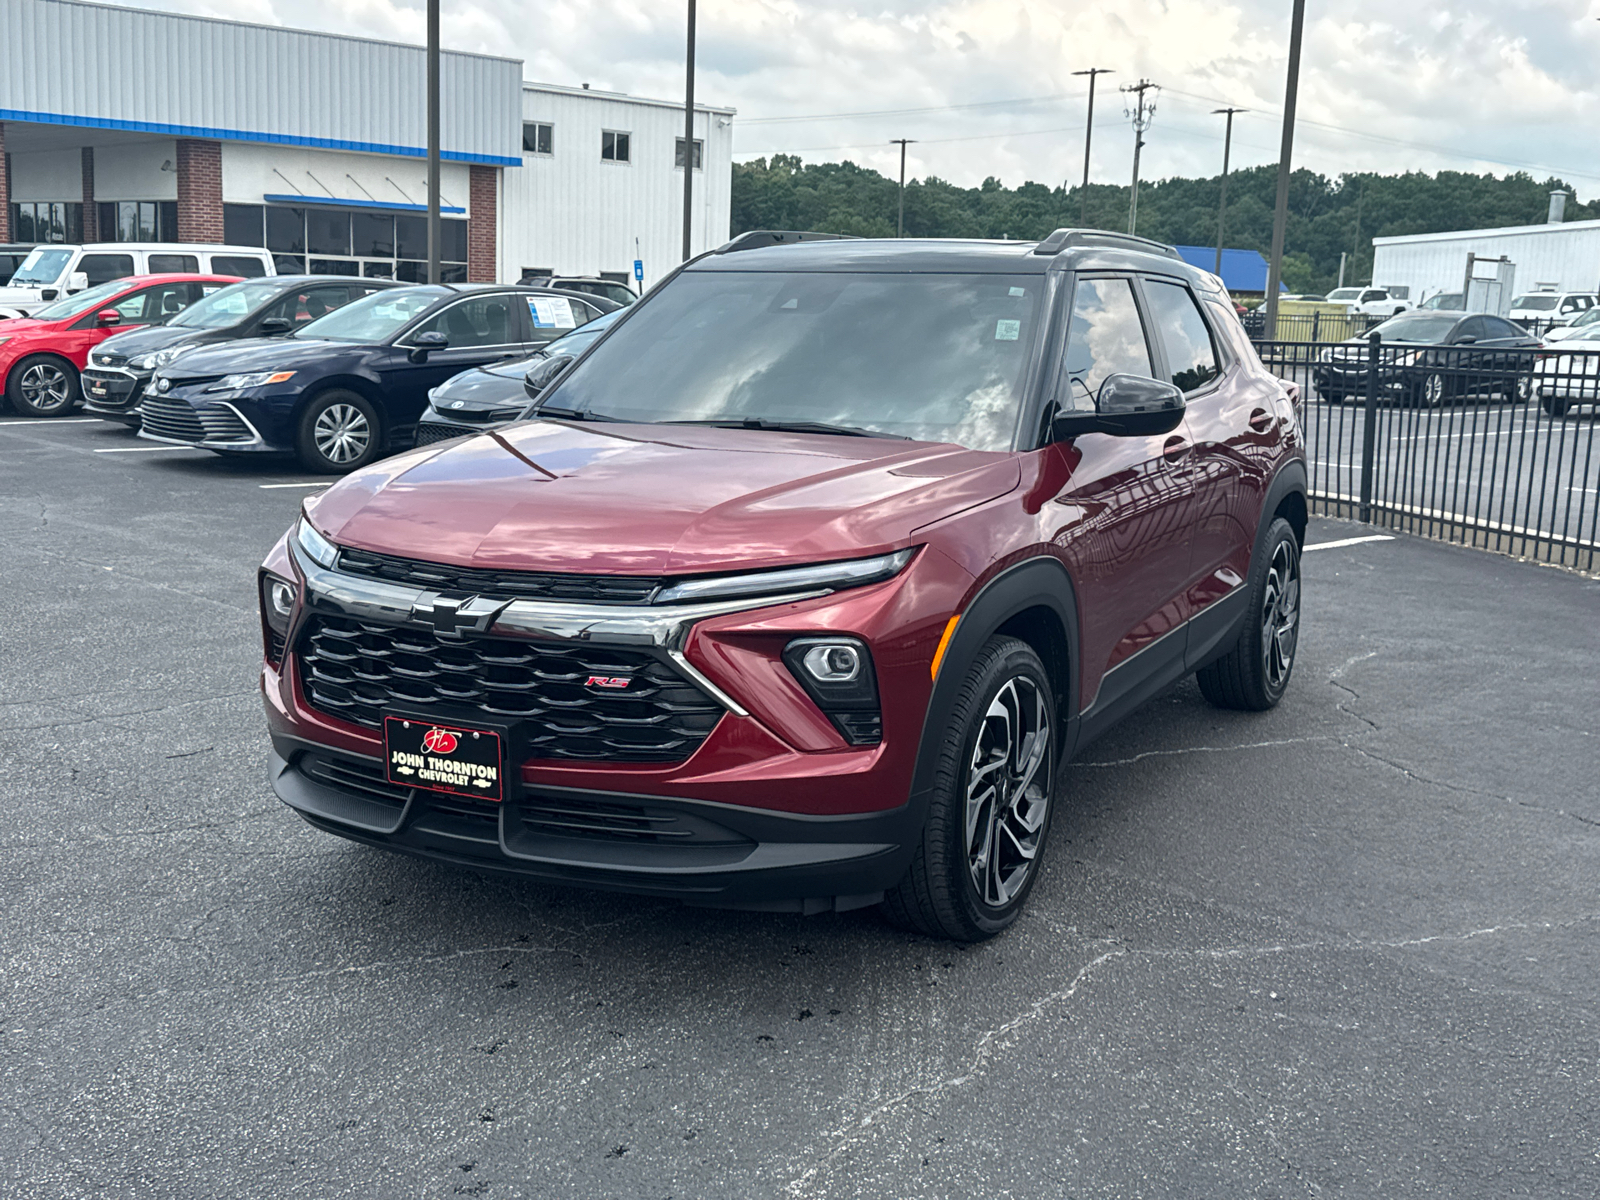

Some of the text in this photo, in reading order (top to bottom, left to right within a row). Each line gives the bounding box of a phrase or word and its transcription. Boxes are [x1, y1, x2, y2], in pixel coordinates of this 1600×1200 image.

[584, 676, 631, 688] RS
[392, 751, 497, 780] JOHN THORNTON
[418, 768, 469, 786] CHEVROLET
